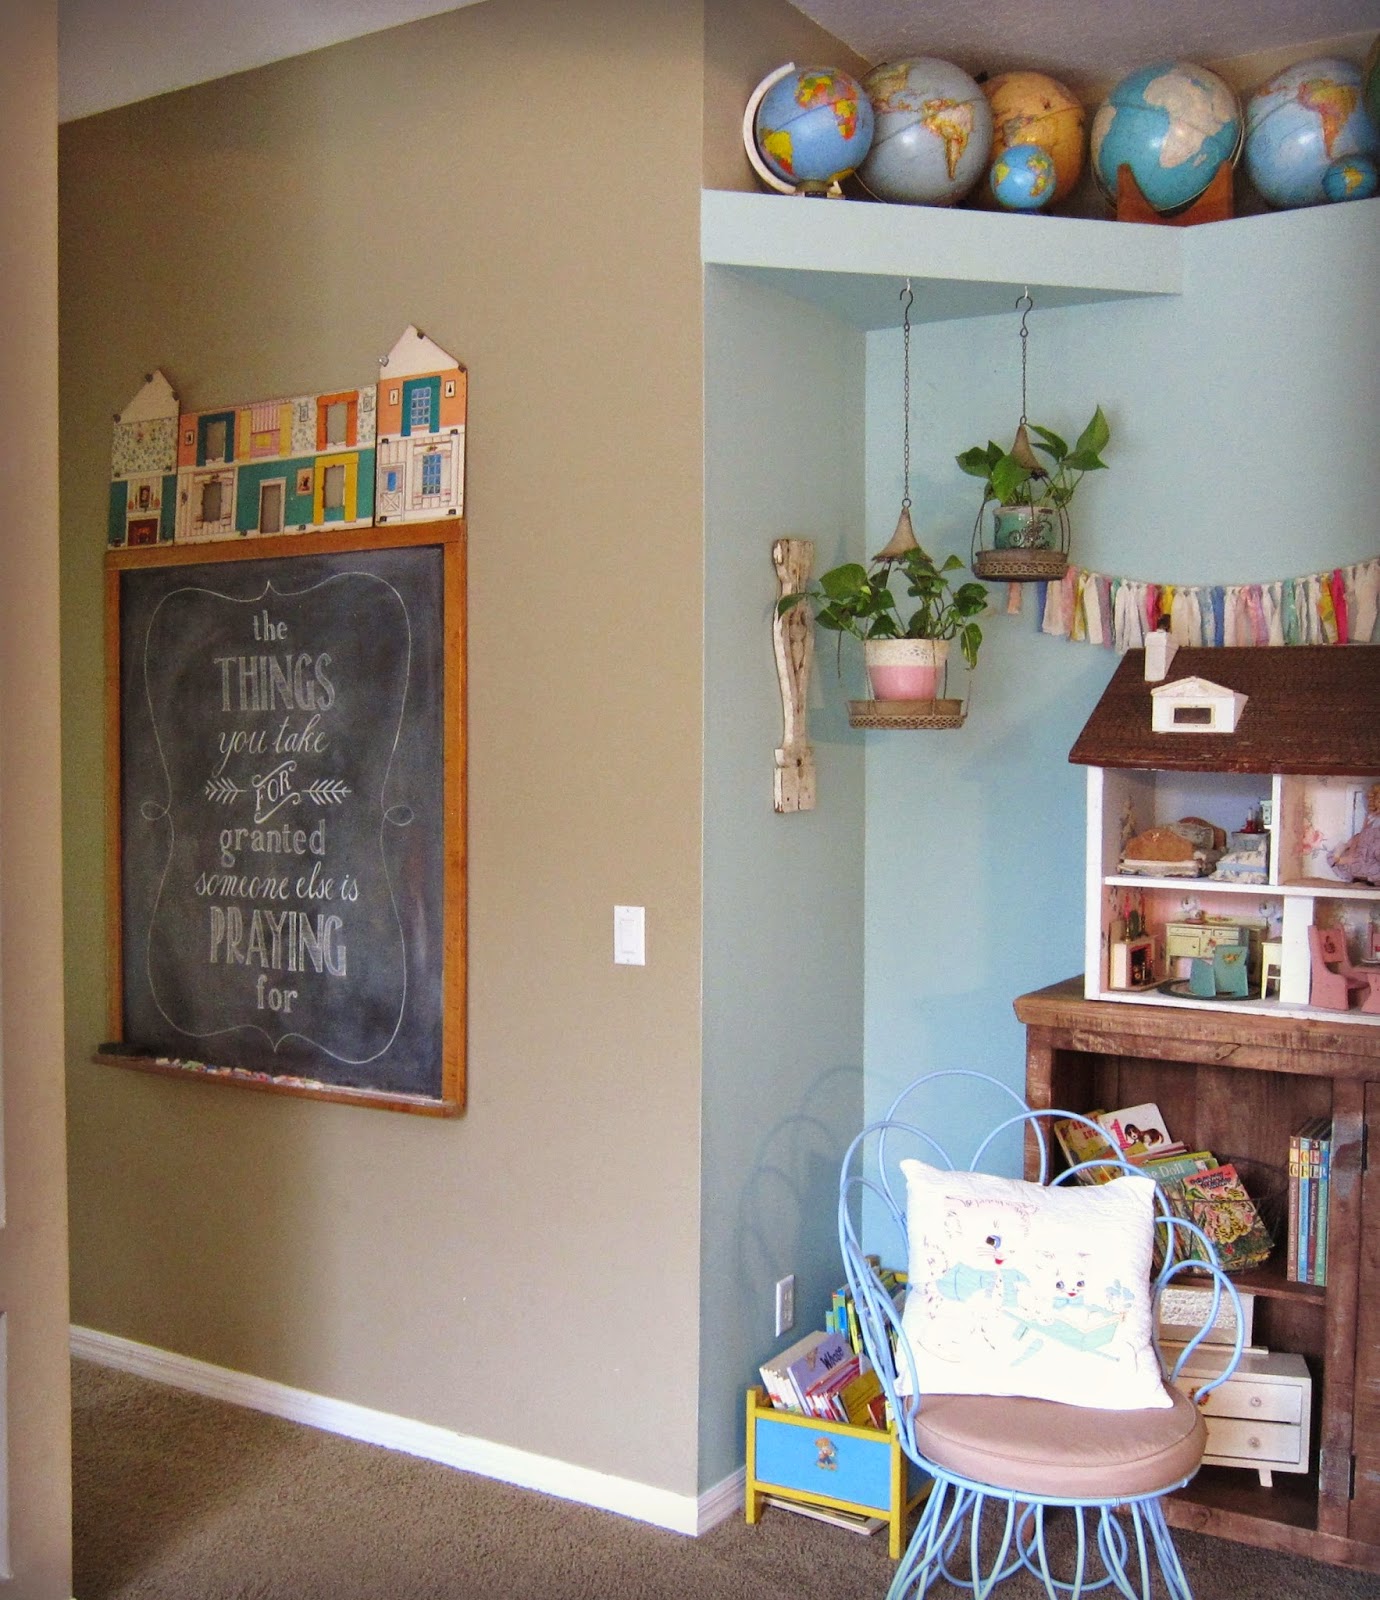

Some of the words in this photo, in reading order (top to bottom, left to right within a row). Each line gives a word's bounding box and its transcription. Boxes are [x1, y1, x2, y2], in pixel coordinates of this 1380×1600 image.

[253, 610, 288, 641] the
[213, 652, 336, 712] THINGS
[211, 730, 267, 778] you
[274, 714, 329, 754] take
[254, 769, 293, 812] FOR
[220, 819, 326, 867] granted
[195, 870, 288, 900] someone
[296, 861, 333, 900] else
[341, 873, 358, 901] is
[209, 905, 347, 977] PRAYING
[256, 974, 298, 1014] for
[1110, 1118, 1131, 1149] 1
